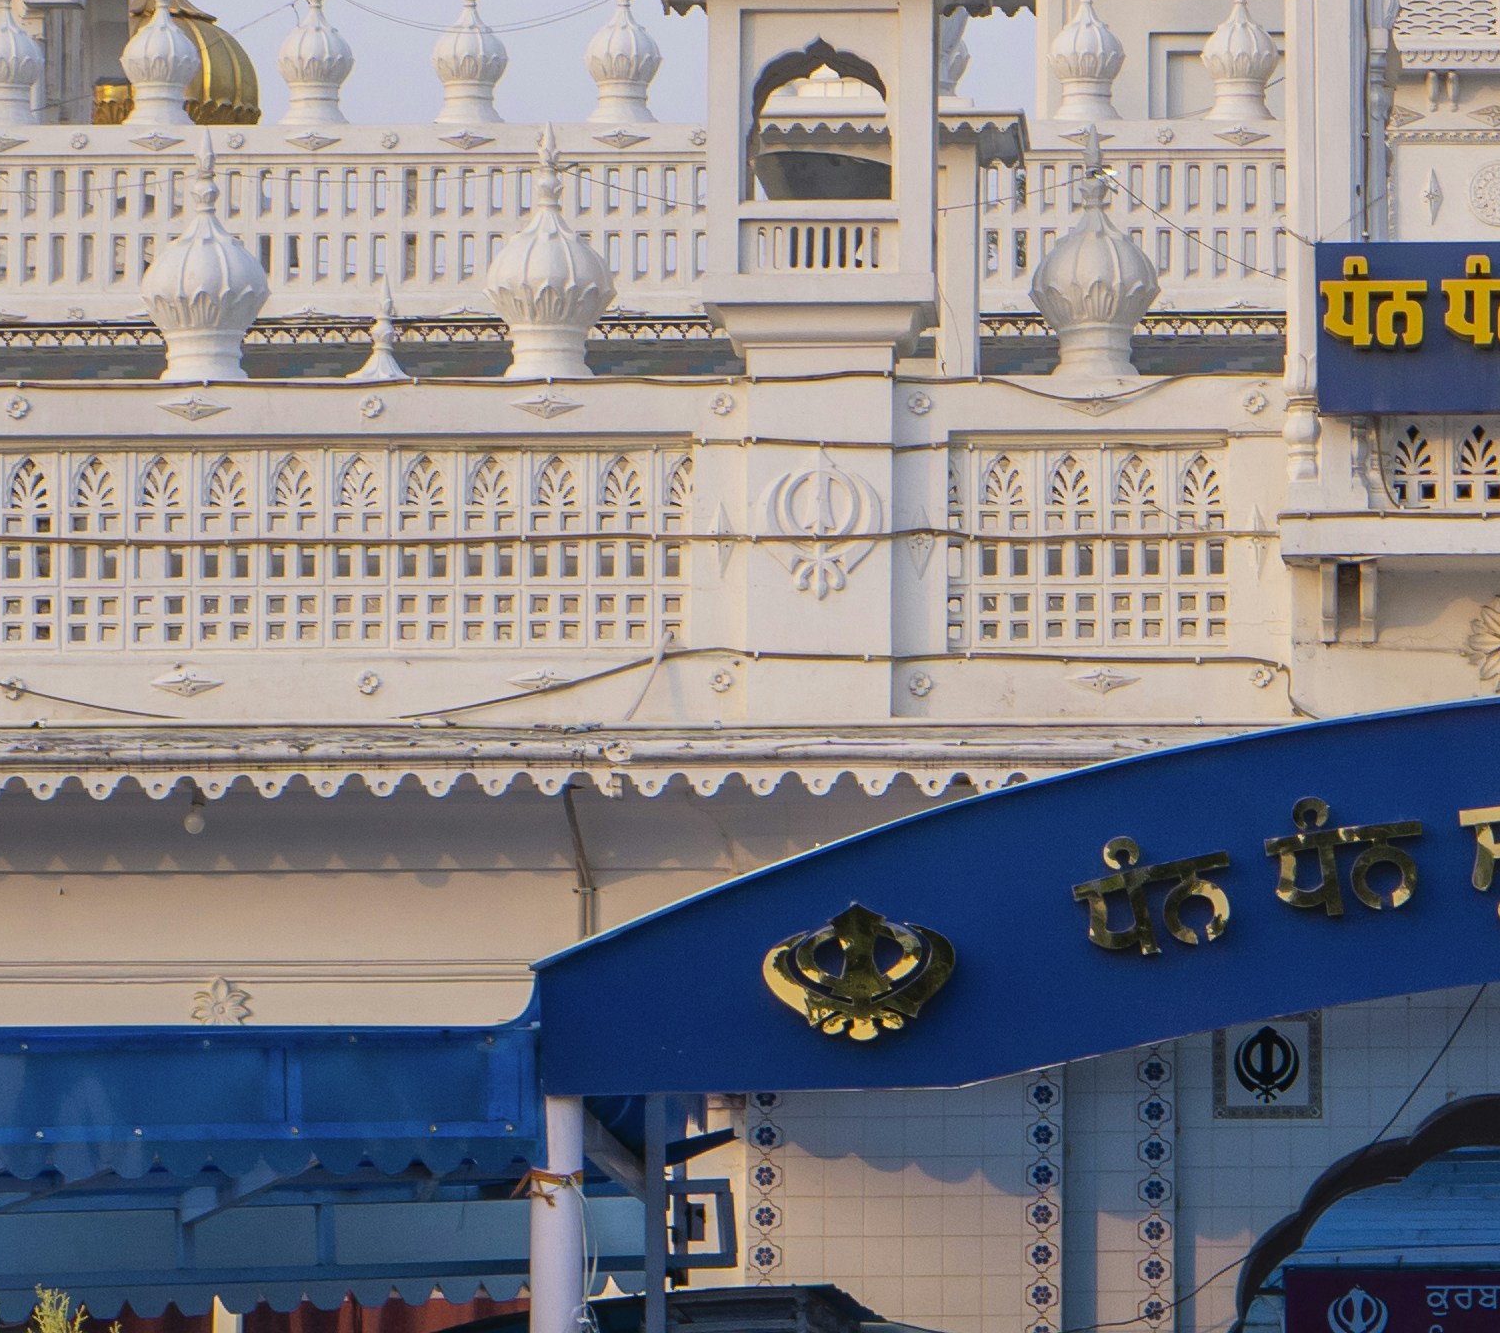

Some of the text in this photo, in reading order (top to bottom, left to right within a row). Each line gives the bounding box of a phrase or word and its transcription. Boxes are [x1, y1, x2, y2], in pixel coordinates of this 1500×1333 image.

[1319, 255, 1428, 347] ਧੰਨ
[1072, 836, 1231, 956] ਧੰਨ
[1263, 796, 1423, 917] ਧੰਨ
